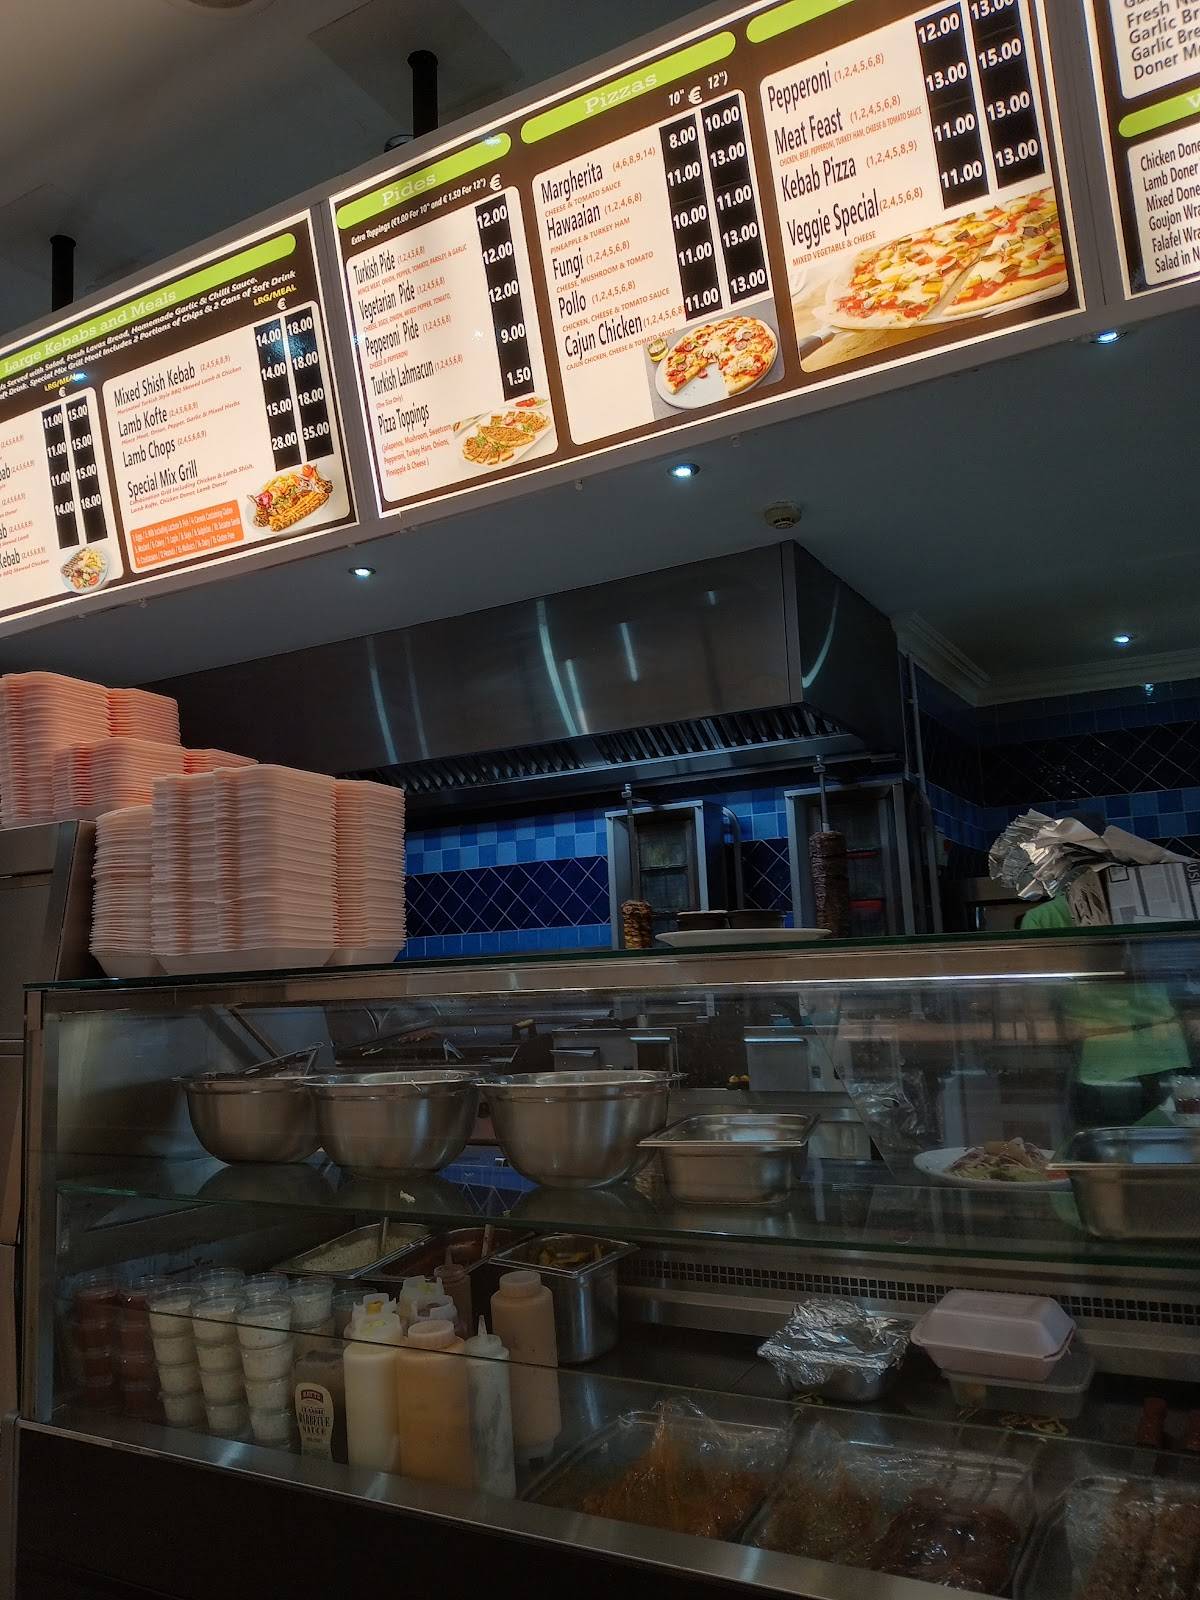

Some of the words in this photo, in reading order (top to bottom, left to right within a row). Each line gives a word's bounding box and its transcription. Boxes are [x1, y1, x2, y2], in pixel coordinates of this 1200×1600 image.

[918, 13, 960, 44] 12.00
[1127, 0, 1170, 28] Fresh
[1129, 17, 1177, 44] Garlic
[926, 61, 968, 92] 13.00
[978, 38, 1022, 69] 15.00
[1131, 36, 1174, 61] Garlic
[767, 60, 831, 114] Pepperoni
[833, 52, 884, 83] (1,2,4,5,6,8)
[1134, 53, 1178, 80] Doner
[583, 73, 657, 114] Pizzas
[669, 89, 685, 106] 10"
[688, 85, 703, 104] €
[669, 125, 696, 149] 8.00
[705, 105, 740, 132] 10.00
[774, 121, 807, 155] Meat
[808, 107, 843, 142] Feast
[850, 94, 901, 124] (1,2,4,5,6,8)
[934, 112, 976, 142] 11.00
[987, 91, 1031, 121] 13.00
[541, 162, 603, 204] Margherita
[612, 146, 656, 172] (4,6,8,9,14)
[667, 161, 701, 187] 11.00
[710, 141, 745, 167] 13.00
[781, 163, 821, 202] Kebab
[822, 156, 857, 187] Pizza
[865, 140, 918, 169] (1,2,4,5,8,9)
[941, 160, 983, 189] 11.00
[995, 139, 1039, 169] 13.00
[1140, 147, 1176, 172] Chicken
[382, 173, 437, 207] Pides
[490, 173, 502, 191] €
[1143, 171, 1168, 192] Lamb
[1170, 162, 1199, 182] Doner
[351, 231, 367, 246] Extra
[366, 223, 391, 241] Toppings
[409, 209, 421, 221] For
[461, 183, 472, 196] For
[544, 203, 568, 218] CHEESE
[573, 190, 601, 205] TOMATO
[601, 181, 621, 195] SAUCE
[546, 203, 601, 241] Hawaaian
[603, 192, 642, 215] (1,2,4,6,8)
[673, 205, 707, 230] 10.00
[717, 184, 752, 211] 11.00
[1146, 188, 1175, 213] Mixed
[477, 205, 508, 230] 12.00
[786, 208, 831, 250] Veggie
[832, 188, 879, 237] Special
[879, 186, 923, 212] (2,4,5,6,8)
[1148, 210, 1182, 232] Goujon
[482, 240, 512, 265] 12.00
[550, 237, 582, 255] PINEAPPLE
[590, 225, 613, 239] TURKEY
[614, 217, 630, 227] HAM
[678, 241, 712, 267] 11.00
[722, 221, 758, 248] 13.00
[792, 254, 812, 266] MIXED
[813, 241, 846, 259] VEGETABLE
[853, 231, 876, 245] CHEESE
[1151, 228, 1182, 253] Falafel
[353, 255, 379, 286] Turkish
[379, 249, 395, 275] Pide
[552, 247, 584, 281] Fungi
[586, 240, 630, 265] (1,2,4,5,6,8)
[580, 265, 619, 285] MUSHROOM
[625, 251, 654, 267] TOMATO
[1155, 254, 1180, 274] Salad
[1181, 251, 1191, 265] in
[254, 283, 297, 307] LRG/MEAL
[276, 297, 287, 311] €
[358, 289, 397, 323] Vegetarian
[398, 279, 415, 305] Pide
[488, 279, 519, 304] 12.00
[558, 290, 586, 319] Pollo
[591, 280, 636, 305] (1,2,4,5,6,8)
[685, 287, 719, 312] 11.00
[730, 268, 766, 295] 13.00
[4, 349, 42, 373] Large
[43, 326, 98, 356] Kebabs
[99, 311, 129, 331] and
[130, 291, 177, 320] Meals
[30, 370, 54, 387] Special
[53, 365, 68, 378] Mix
[68, 357, 85, 371] Grill
[84, 350, 102, 365] Meal
[139, 322, 171, 342] Portions
[172, 315, 181, 328] of
[181, 308, 205, 325] Chips
[204, 304, 213, 315] &
[213, 300, 219, 311] 2
[219, 293, 242, 308] Cans
[241, 286, 253, 300] of
[252, 280, 271, 295] Soft
[270, 269, 297, 287] Drink
[66, 349, 86, 363] Fresh
[130, 309, 174, 335] Homemade
[174, 300, 199, 317] Garlic
[200, 295, 208, 307] &
[208, 287, 231, 303] Chilli
[255, 327, 281, 347] 14.00
[286, 315, 313, 335] 18.00
[365, 323, 401, 360] Pepperoni
[402, 317, 420, 343] Pide
[500, 322, 525, 344] 9.00
[564, 331, 596, 361] Cajun
[598, 314, 642, 345] Chicken
[260, 361, 287, 382] 14.00
[292, 350, 318, 370] 18.00
[371, 367, 397, 397] Turkish
[397, 360, 434, 388] Lahmacun
[506, 366, 531, 387] 1.50
[114, 381, 141, 408] Mixed
[141, 372, 166, 398] Shish
[166, 361, 196, 389] Kebab
[43, 412, 63, 430] 11.00
[67, 404, 87, 422] 15.00
[266, 398, 292, 417] 15.00
[297, 387, 324, 406] 18.00
[377, 413, 397, 435] Pizza
[396, 402, 430, 433] Toppings
[117, 413, 142, 438] Lamb
[143, 406, 168, 429] Kofte
[271, 431, 298, 451] 28.00
[302, 421, 330, 441] 35.00
[46, 440, 67, 459] 11.00
[71, 433, 92, 451] 15.00
[122, 444, 147, 468] Lamb
[148, 438, 176, 460] Chops
[50, 471, 71, 488] 11.00
[75, 463, 97, 480] 15.00
[127, 474, 159, 501] Special
[159, 468, 177, 489] Mix
[178, 459, 198, 482] Grill
[54, 500, 75, 517] 14.00
[80, 493, 102, 511] 18.00
